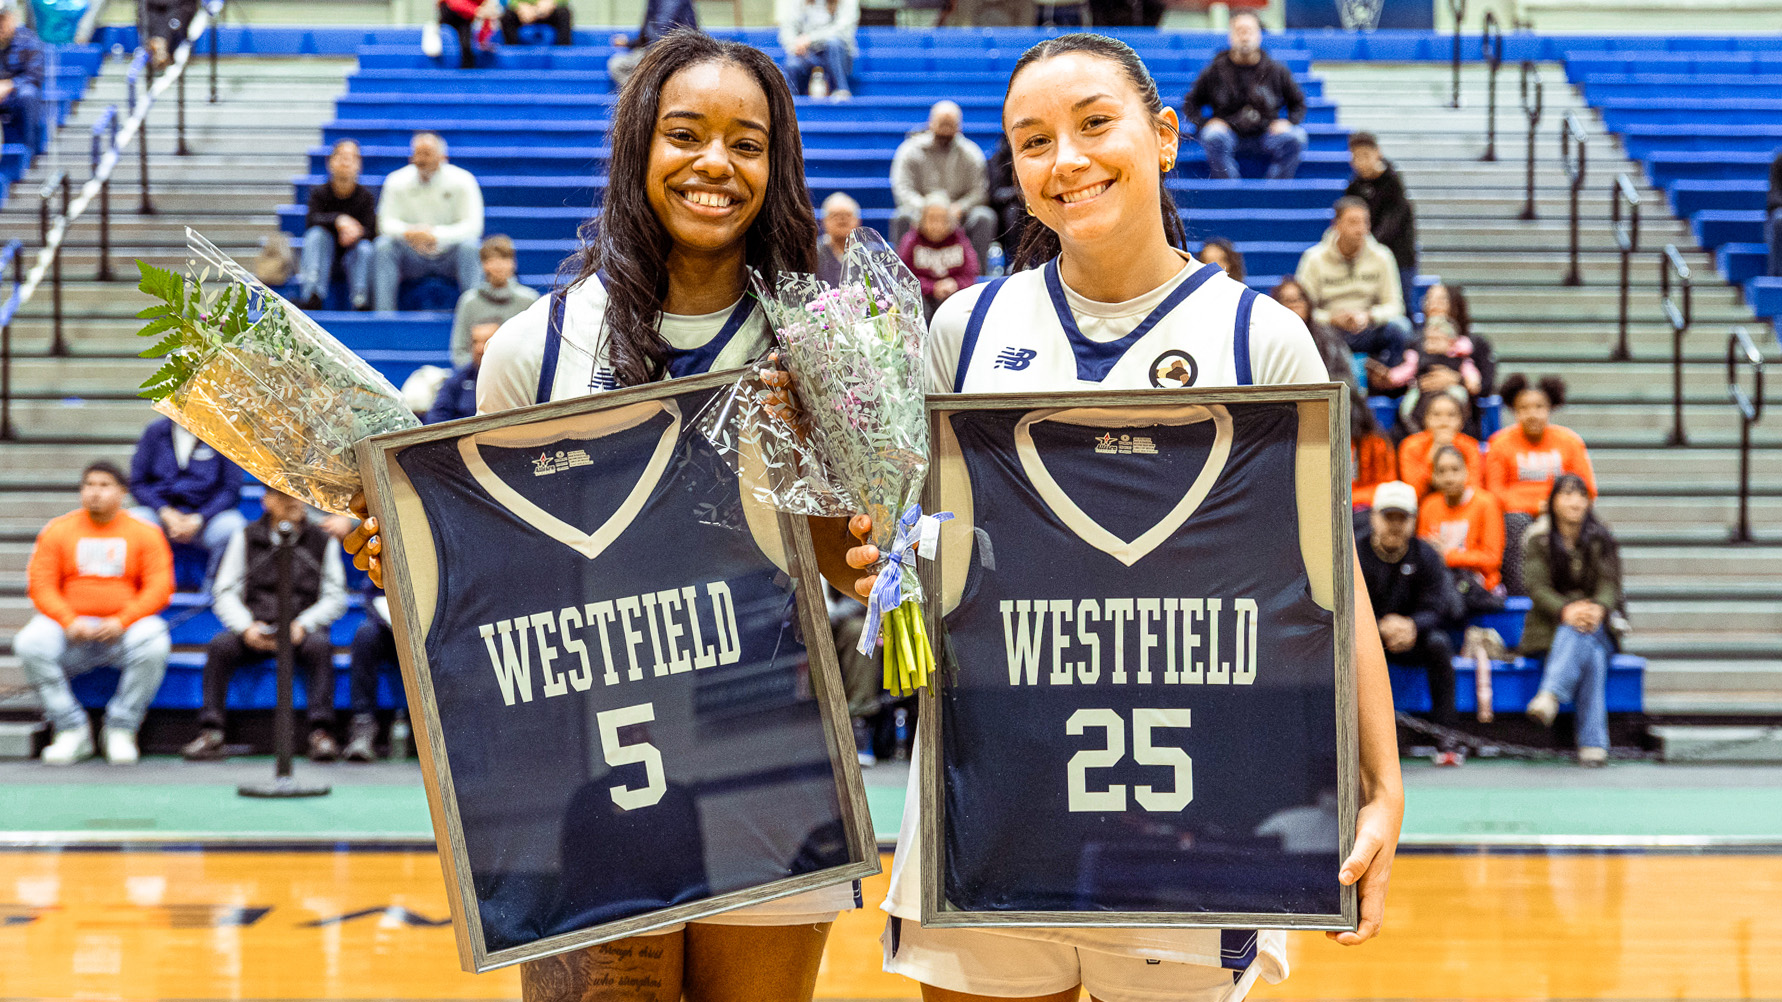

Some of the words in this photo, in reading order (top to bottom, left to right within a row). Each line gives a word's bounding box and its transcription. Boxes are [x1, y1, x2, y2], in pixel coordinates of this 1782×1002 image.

[479, 581, 741, 706] WESTFIELD
[1000, 598, 1258, 685] WESTFIELD
[597, 702, 667, 811] 5
[1066, 708, 1193, 812] 25
[593, 973, 614, 986] who
